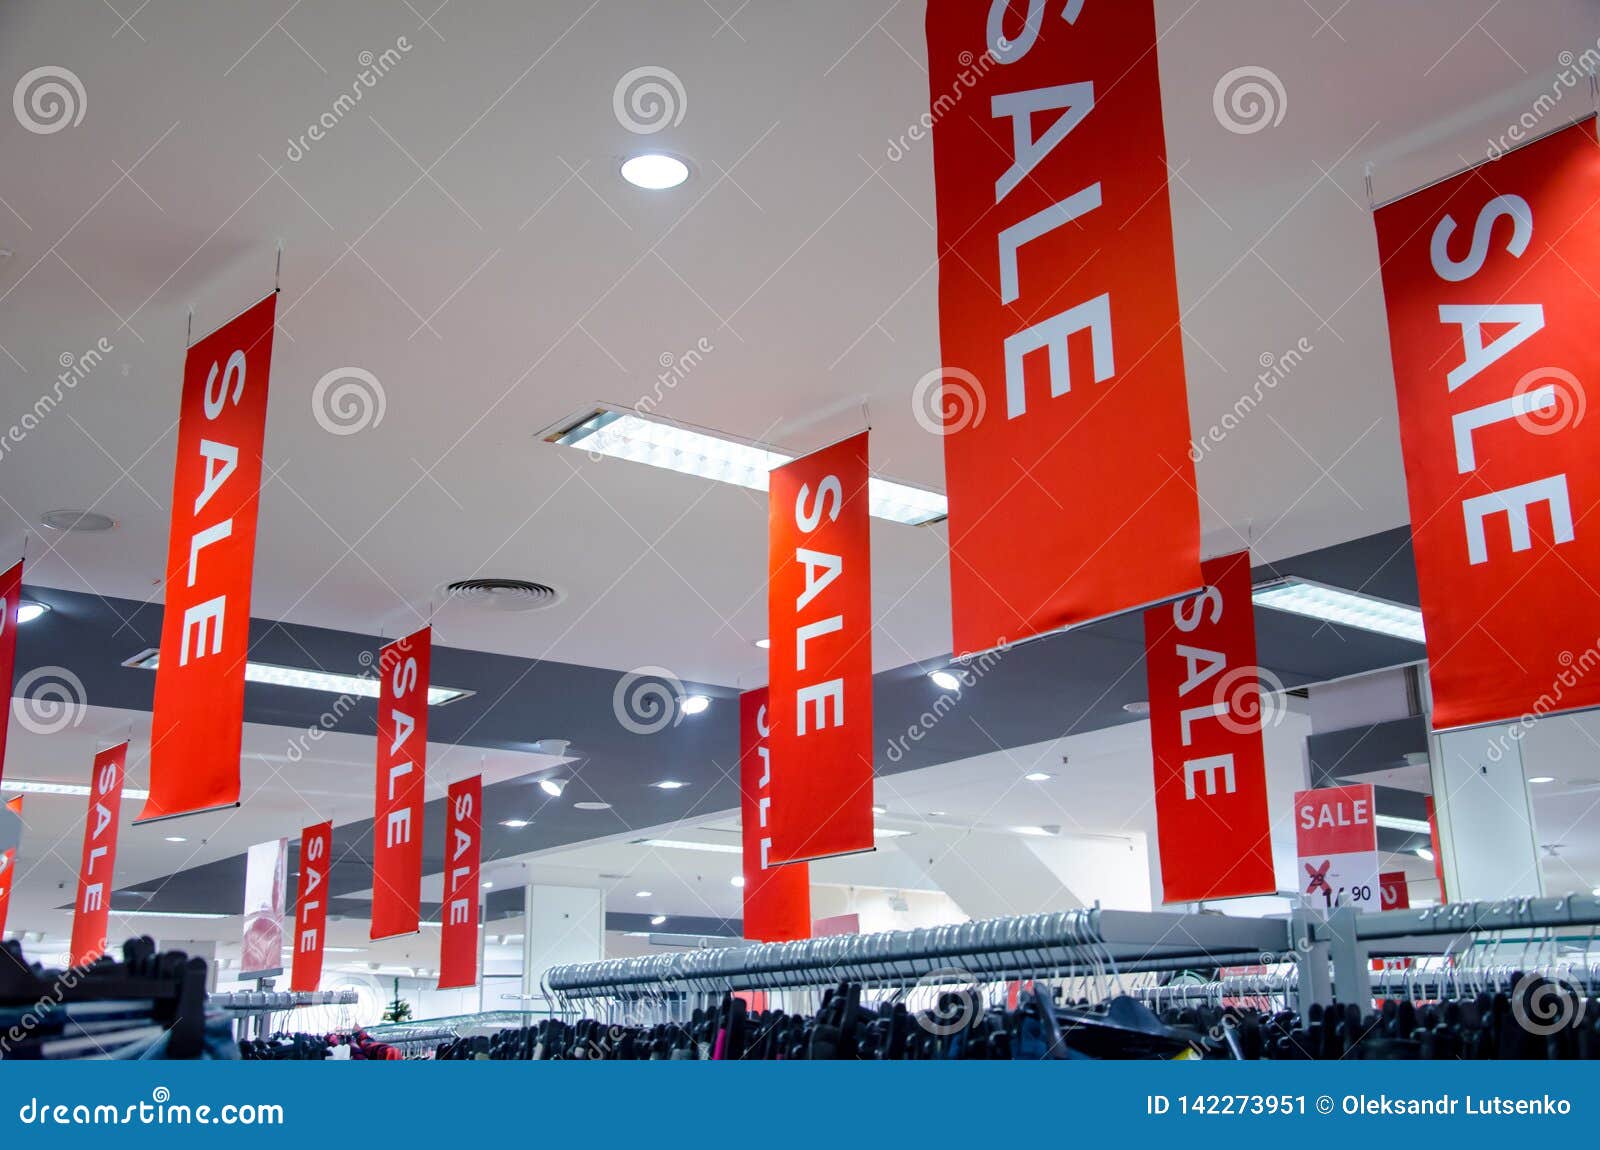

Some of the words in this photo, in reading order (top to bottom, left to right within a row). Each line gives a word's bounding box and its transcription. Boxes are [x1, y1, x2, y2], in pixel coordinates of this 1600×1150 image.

[986, 0, 1116, 421] SALE
[1429, 194, 1576, 566] SALE
[178, 348, 247, 667] SALE
[794, 473, 845, 738] SALE
[1172, 585, 1237, 801] SALE
[82, 762, 117, 915] SALE
[387, 656, 418, 850] SALE
[1300, 799, 1369, 830] SALE
[300, 835, 324, 954] SALE
[449, 792, 473, 927] SALE
[1351, 885, 1371, 901] 90
